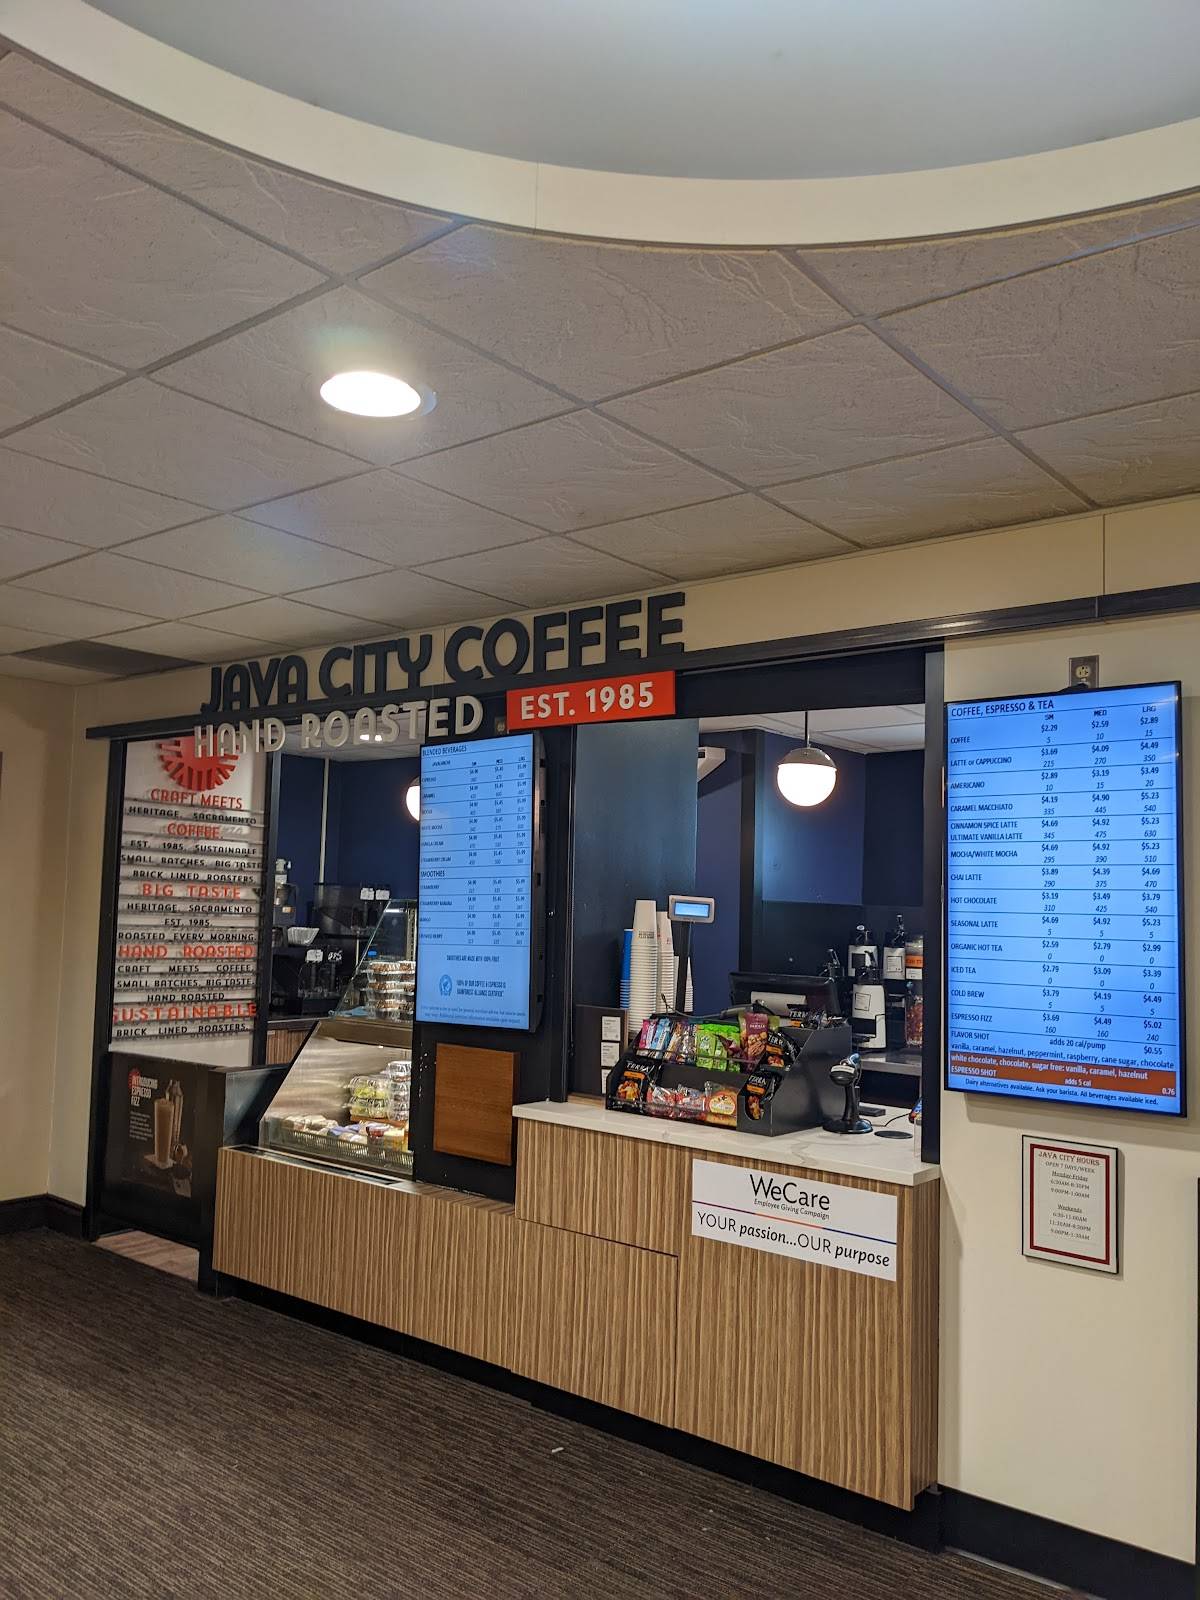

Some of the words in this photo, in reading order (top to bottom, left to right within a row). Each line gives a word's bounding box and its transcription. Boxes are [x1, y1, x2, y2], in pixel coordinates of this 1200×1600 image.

[200, 654, 308, 715] JAVA
[318, 635, 433, 698] CITY
[444, 591, 685, 682] COFFEE
[520, 691, 576, 721] EST.
[585, 681, 654, 713] 1985
[951, 706, 983, 717] COFFEE,
[986, 703, 1025, 713] ESPRESSO
[1028, 701, 1035, 710] &
[1038, 701, 1054, 709] TEA
[194, 715, 286, 758] HAND
[302, 695, 484, 749] ROASTED
[1041, 724, 1058, 732] $2.29
[1092, 720, 1109, 728] $2.59
[1140, 716, 1158, 724] $2.89
[1092, 744, 1109, 753] $4.09
[1092, 769, 1109, 777] $3.19
[151, 789, 196, 806] CRAFT
[201, 793, 242, 808] MEETS
[1141, 792, 1159, 800] $5.23
[128, 807, 182, 817] HERITAGE.
[194, 813, 256, 824] SACRAMENTO
[1092, 818, 1110, 826] $4.92
[1141, 817, 1160, 825] $5.23
[168, 823, 224, 839] COFFEE.
[163, 842, 186, 850] 1985.
[195, 845, 256, 855] SUSTAINABLE
[1092, 843, 1110, 851] $4.92
[1142, 842, 1160, 850] $5.23
[161, 857, 207, 867] BATCHES.
[207, 874, 257, 883] ROASTERS.
[1093, 868, 1110, 876] $4.39
[1142, 867, 1160, 876] $4.69
[143, 883, 173, 896] BIG
[188, 885, 241, 898] TASTE
[1093, 893, 1110, 901] $3.49
[1142, 892, 1160, 901] $3.79
[127, 903, 178, 911] HERITAGE.
[1093, 917, 1111, 926] $4.92
[1142, 918, 1160, 927] $5.23
[119, 945, 168, 958] HAND
[183, 946, 254, 959] ROASTED
[1093, 942, 1111, 950] $2.79
[1143, 943, 1161, 952] $2.99
[1094, 967, 1111, 976] $3.09
[1143, 969, 1162, 978] $3.39
[1043, 989, 1059, 997] $3.79
[1094, 992, 1111, 1000] $4.19
[1143, 994, 1162, 1004] $4.49
[1043, 1014, 1060, 1022] $3.69
[1094, 1017, 1112, 1026] $4.49
[1144, 1020, 1162, 1029] $5.02
[117, 1028, 147, 1037] BRICK
[158, 1026, 187, 1035] LINED
[199, 1024, 248, 1032] ROASTERS.
[1075, 1040, 1106, 1050] cal/pump
[1144, 1046, 1162, 1055] $0.55
[1039, 1151, 1057, 1159] JAVA
[1076, 1157, 1100, 1165] HOURS
[750, 1174, 830, 1210] WeCare
[754, 1199, 779, 1209] Employee
[781, 1203, 799, 1214] Giving
[800, 1207, 830, 1220] Campaign
[698, 1212, 736, 1232] YOUR
[835, 1244, 890, 1267] purpose
